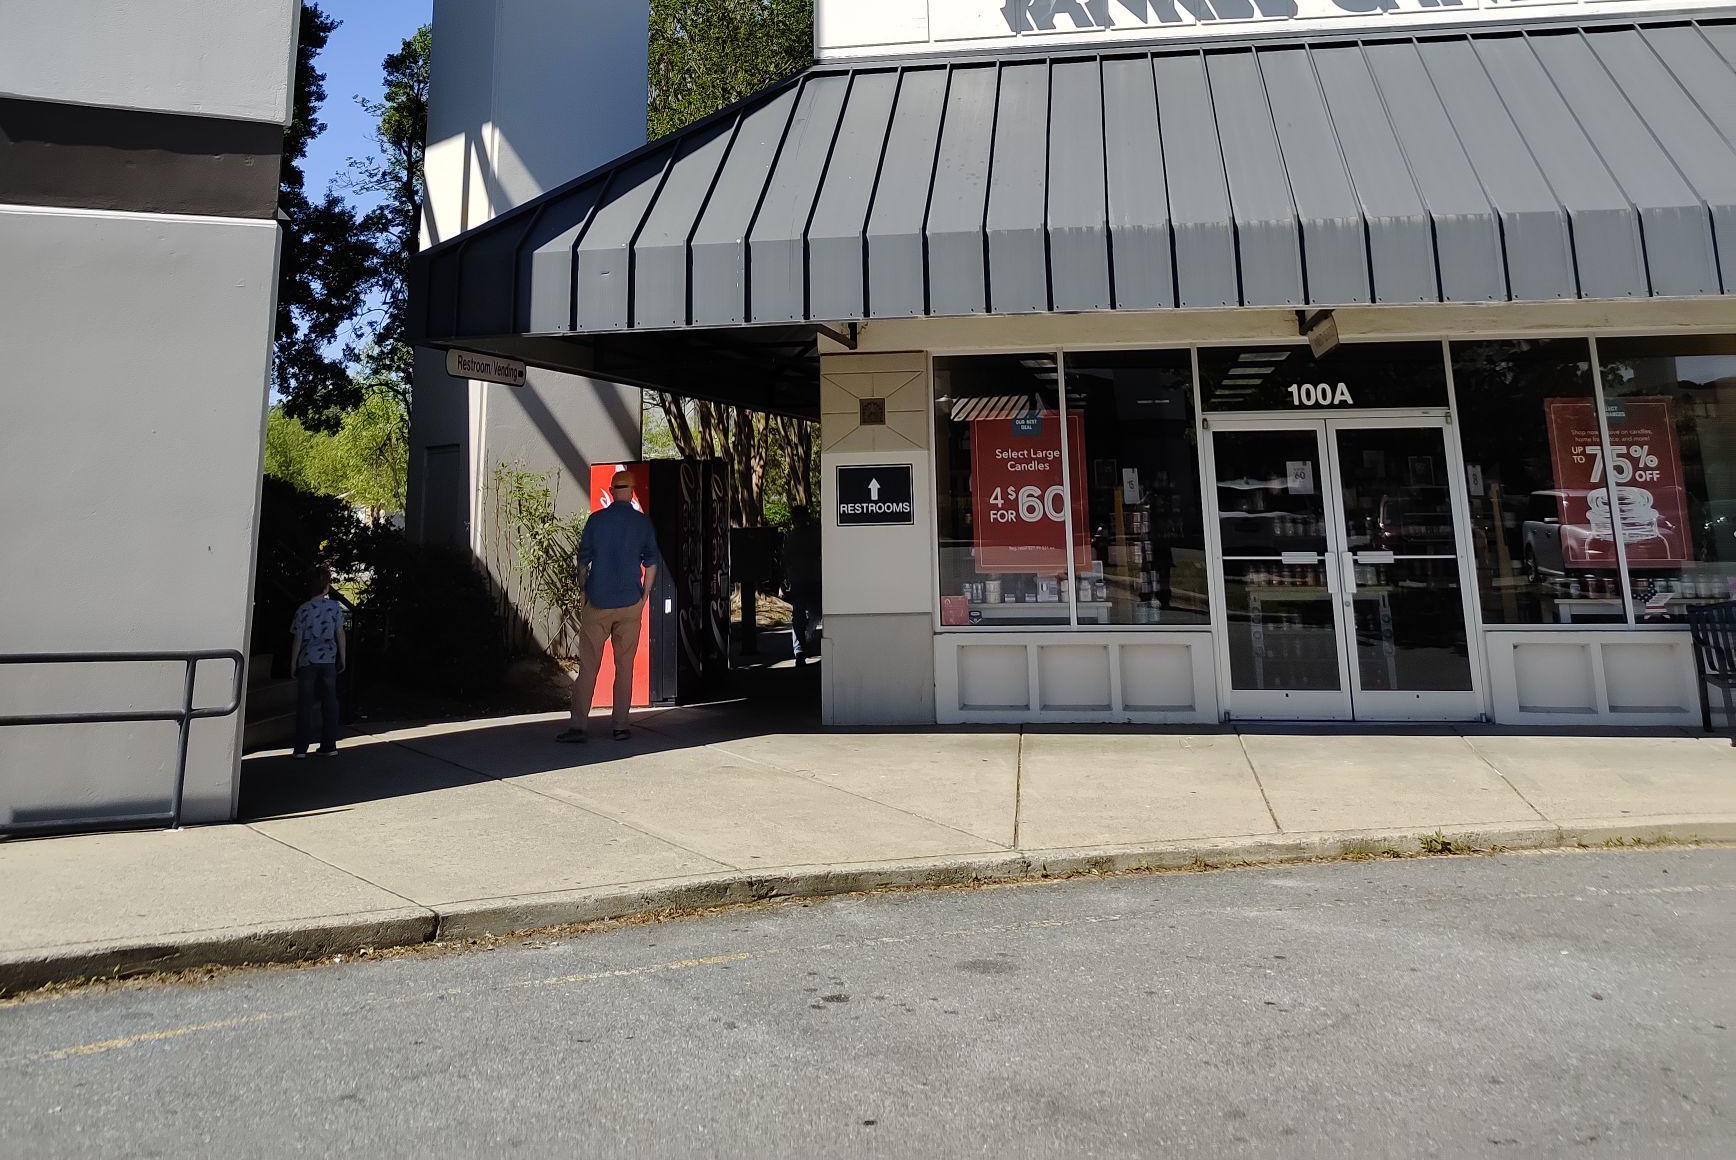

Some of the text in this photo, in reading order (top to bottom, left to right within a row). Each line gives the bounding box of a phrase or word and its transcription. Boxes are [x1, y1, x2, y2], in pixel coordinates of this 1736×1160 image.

[1287, 382, 1354, 406] 100A
[995, 448, 1061, 460] Select Large
[1571, 446, 1584, 454] UP
[1572, 455, 1586, 463] TO
[1007, 461, 1050, 471] Candles
[1635, 470, 1660, 482] OFF
[989, 486, 1005, 508] 4
[840, 502, 910, 514] RESTROOMS
[989, 510, 1017, 523] FOR
